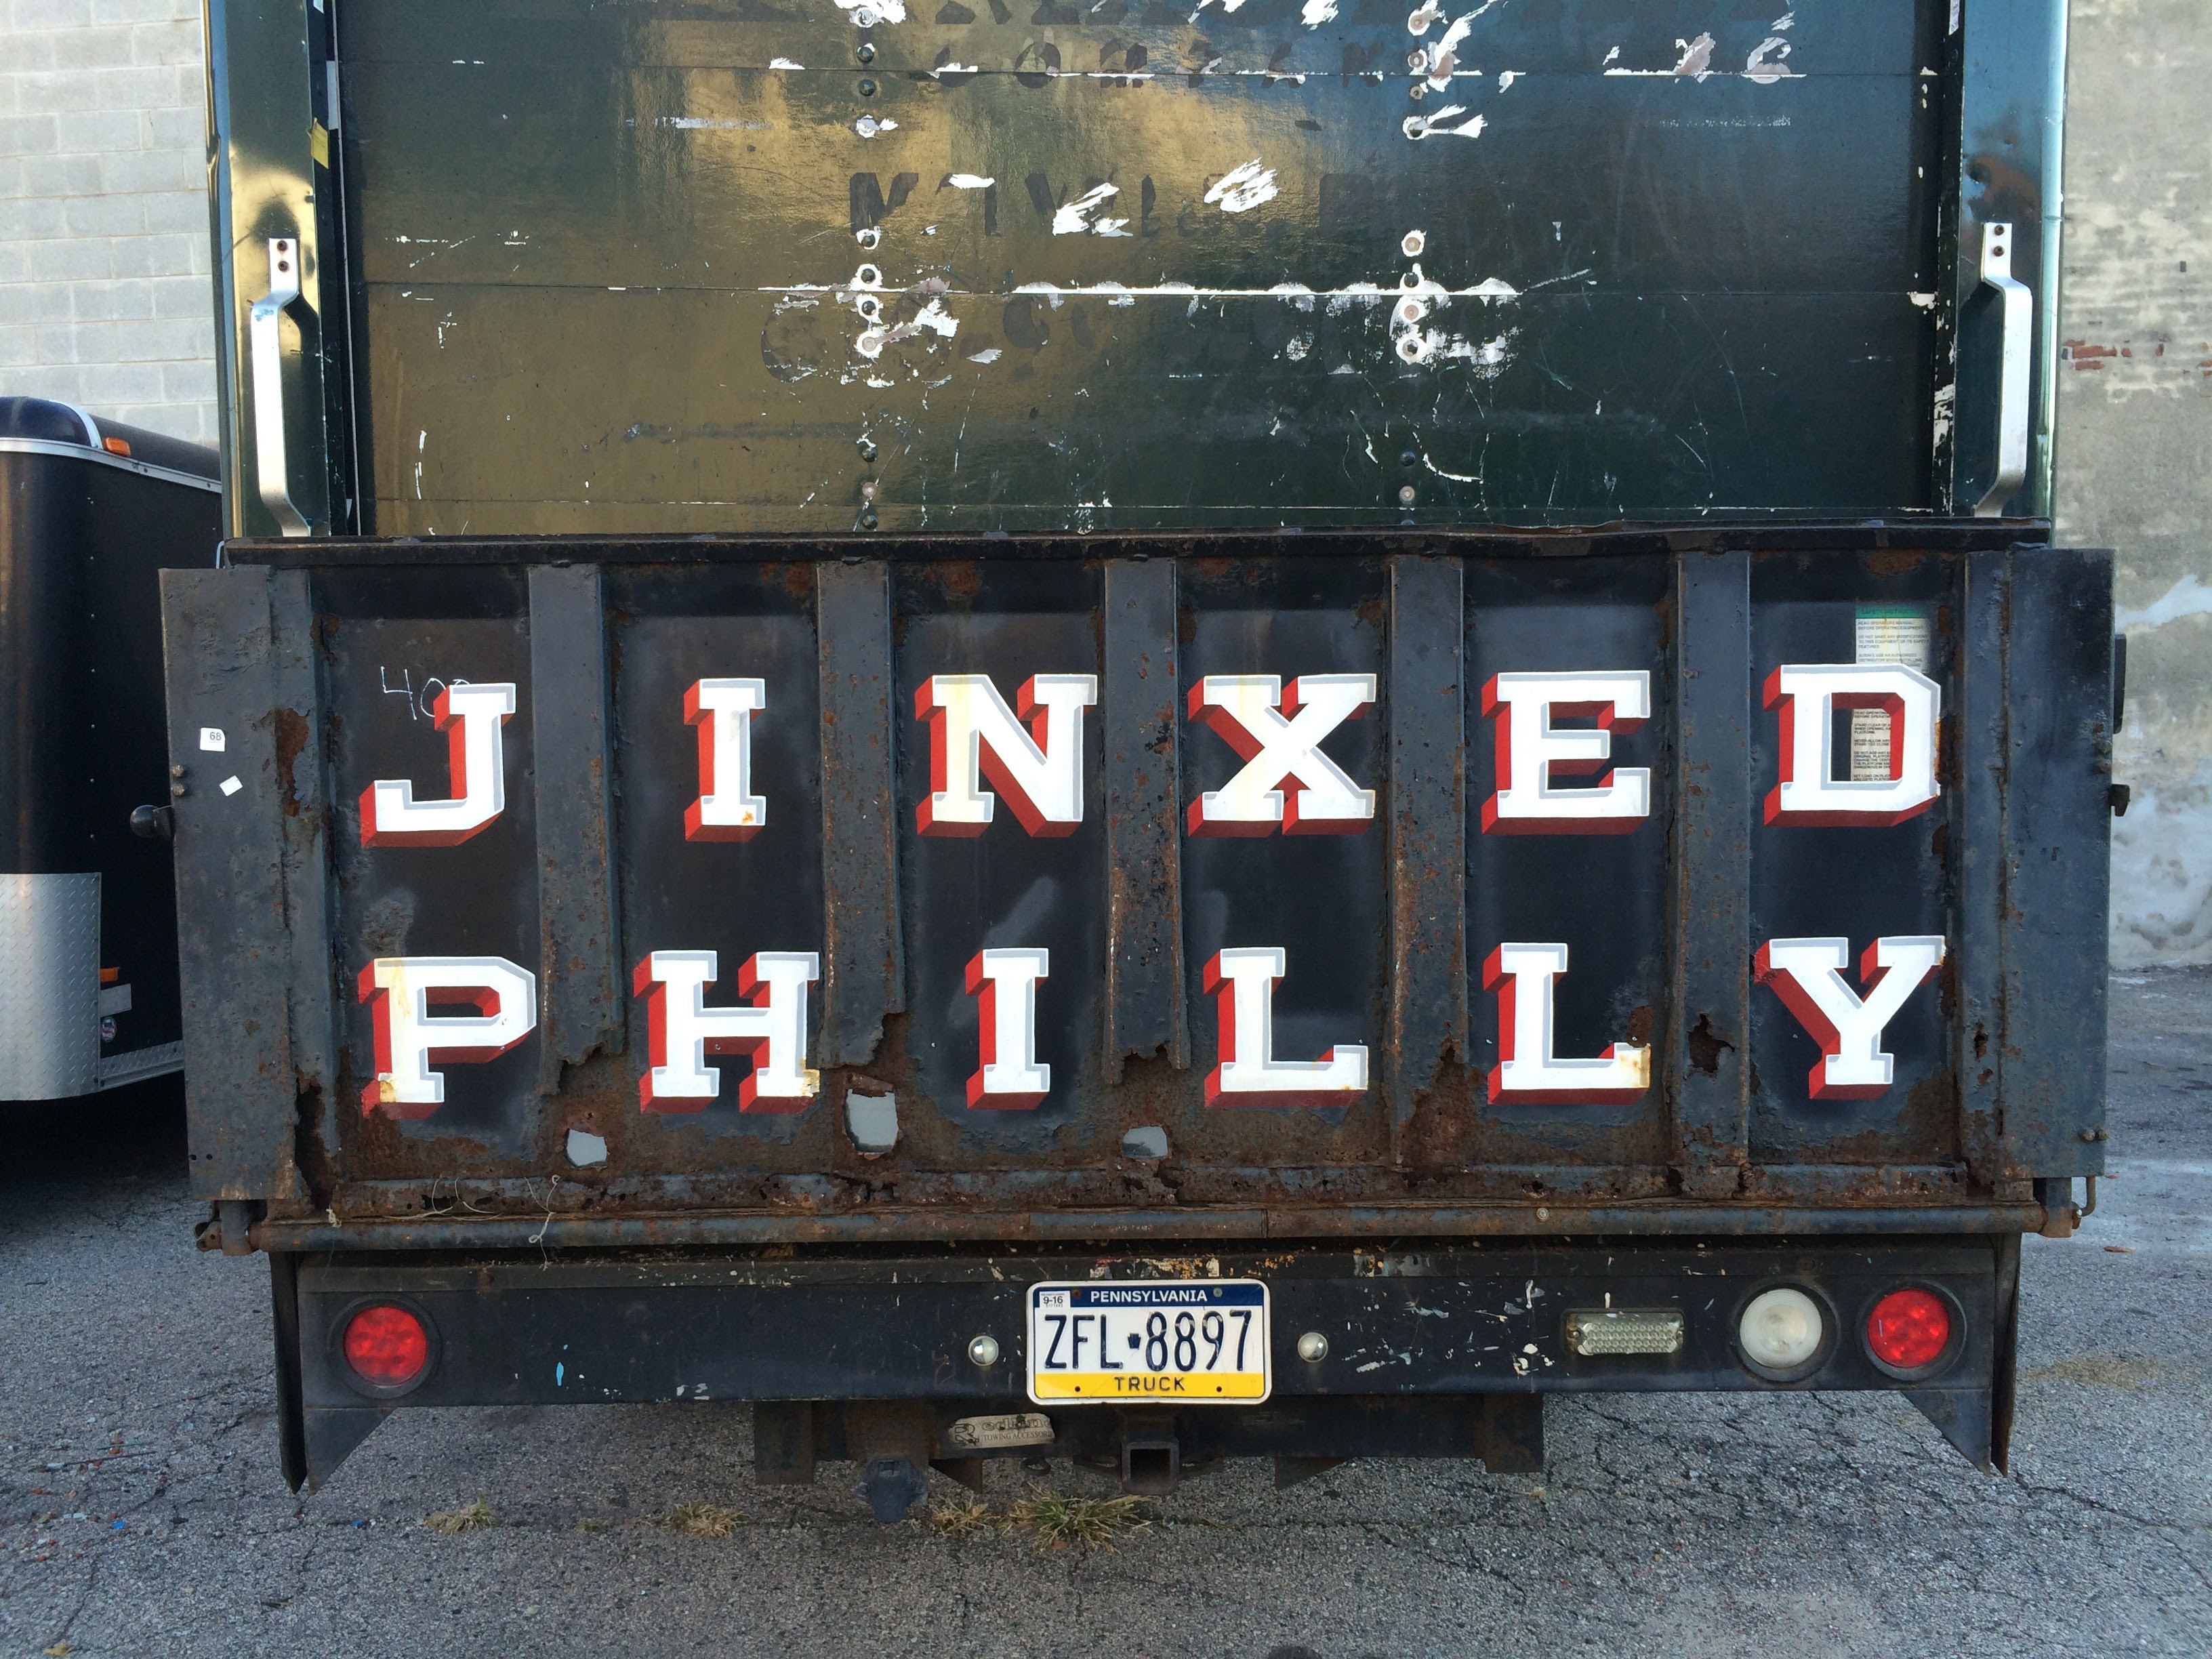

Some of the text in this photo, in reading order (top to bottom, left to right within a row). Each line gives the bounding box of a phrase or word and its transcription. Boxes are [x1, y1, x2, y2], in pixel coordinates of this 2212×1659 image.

[209, 732, 222, 741] 68
[359, 663, 1943, 847] JINXED
[358, 935, 1946, 1118] PHILLY
[1043, 1296, 1063, 1305] 9-16
[1090, 1290, 1208, 1303] PENNSYLVANIA
[1113, 1376, 1186, 1392] TRUCK
[983, 1431, 1010, 1441] TOWING
